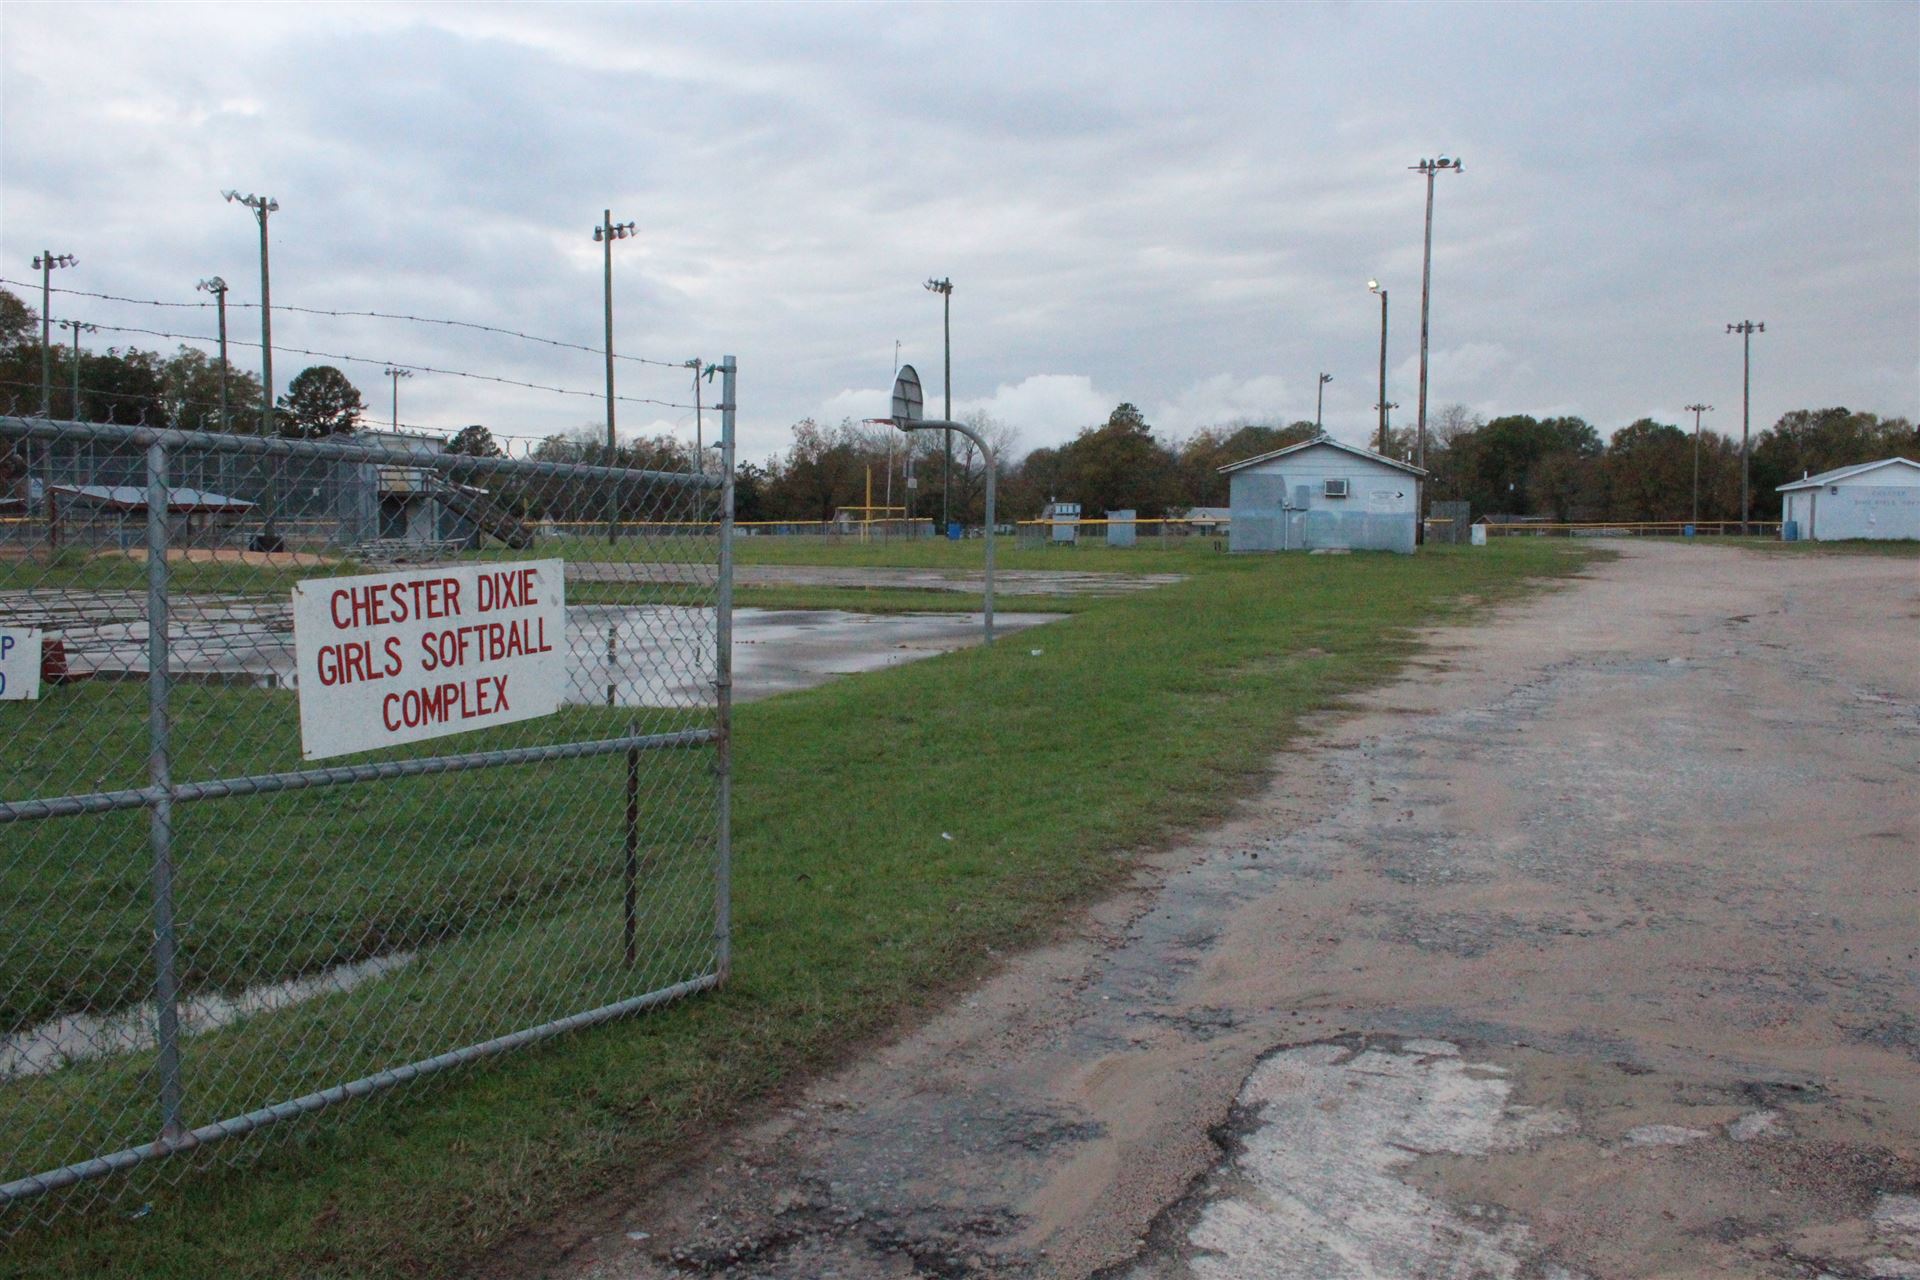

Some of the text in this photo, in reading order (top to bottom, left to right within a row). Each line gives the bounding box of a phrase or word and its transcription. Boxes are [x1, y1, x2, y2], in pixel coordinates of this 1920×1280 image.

[331, 569, 538, 629] CHESTER DIXIE
[317, 617, 552, 686] GIRLS SOFTBALL
[383, 675, 509, 731] COMPLEX
